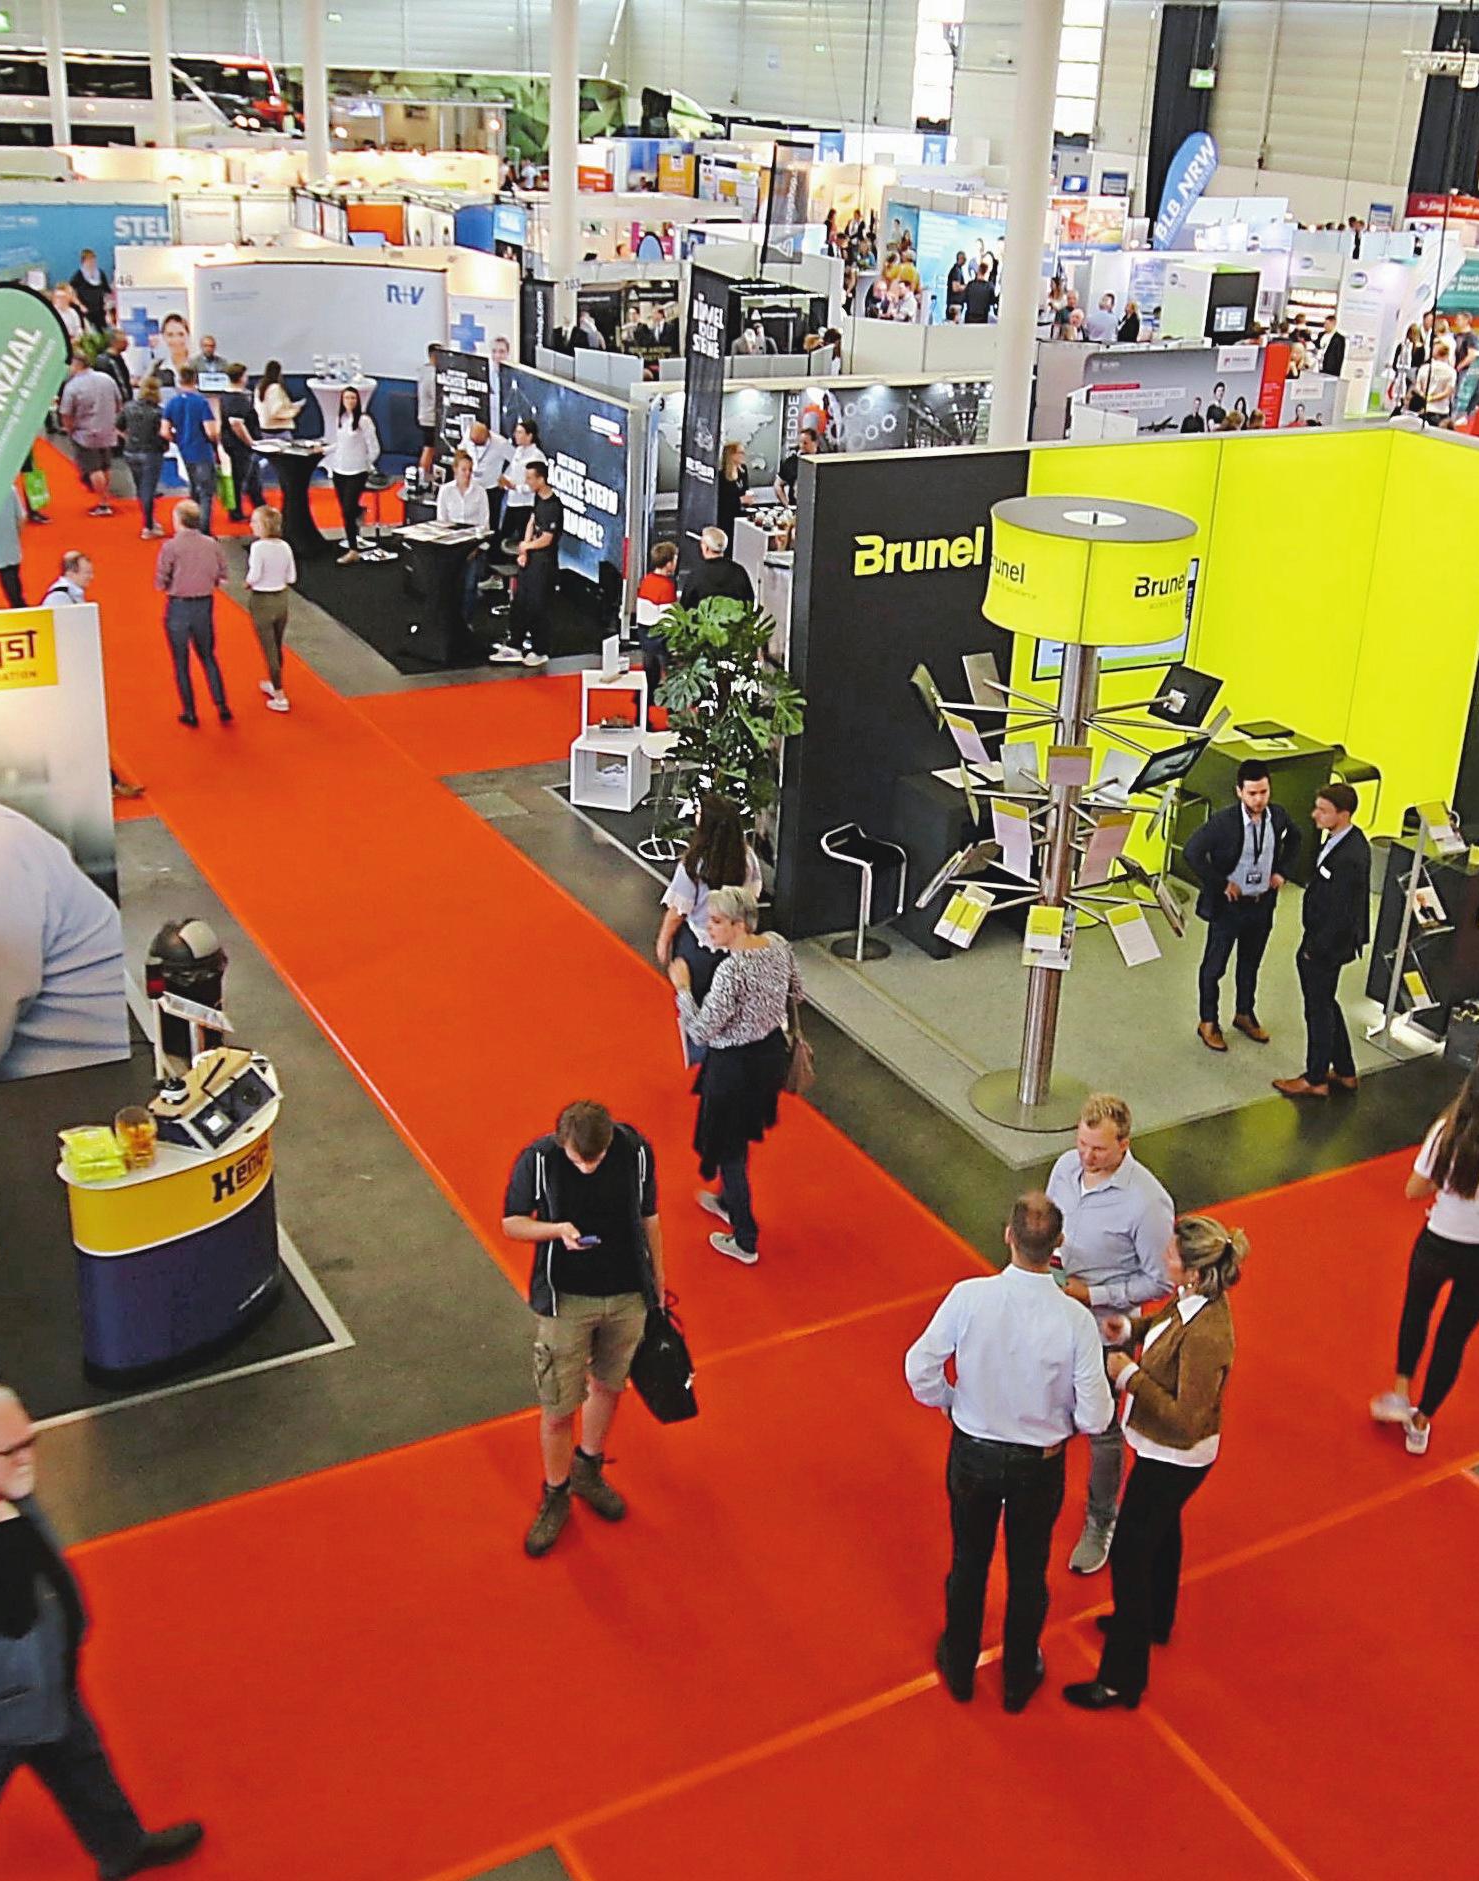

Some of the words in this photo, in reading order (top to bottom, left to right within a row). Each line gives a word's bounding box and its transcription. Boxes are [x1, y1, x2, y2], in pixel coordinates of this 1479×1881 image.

[1154, 198, 1181, 241] BLB
[1178, 135, 1218, 200] NRW
[386, 284, 425, 305] R+V
[854, 526, 985, 576] Brunel
